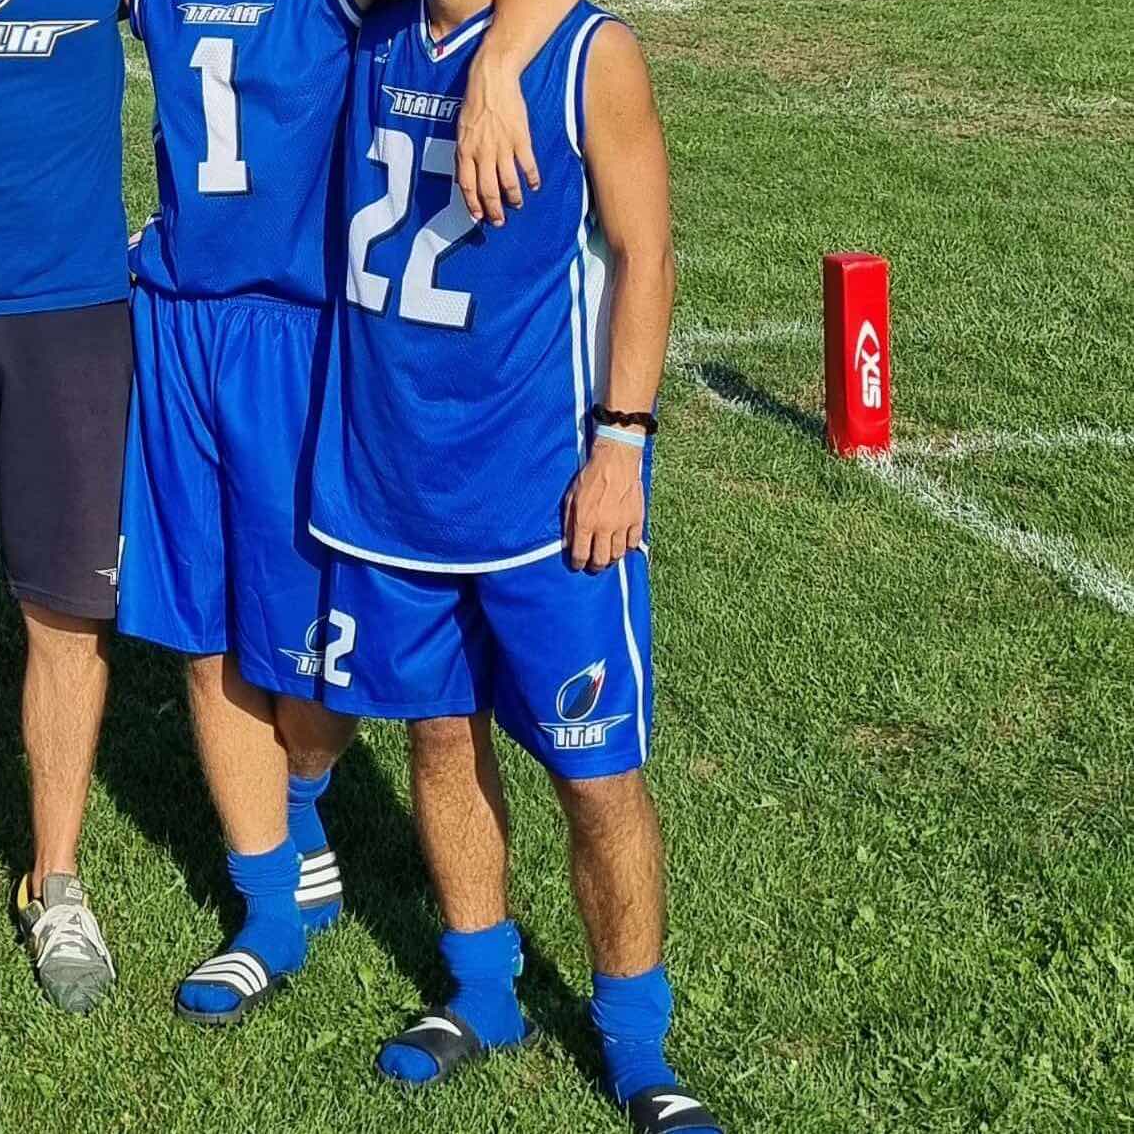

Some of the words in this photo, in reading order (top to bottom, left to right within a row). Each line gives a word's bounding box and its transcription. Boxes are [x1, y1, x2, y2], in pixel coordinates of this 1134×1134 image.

[185, 5, 263, 23] ITALIA
[189, 37, 251, 194] 1
[394, 91, 459, 119] ITALIA
[346, 128, 482, 329] 22
[298, 655, 323, 673] IT
[552, 724, 608, 748] ITA
